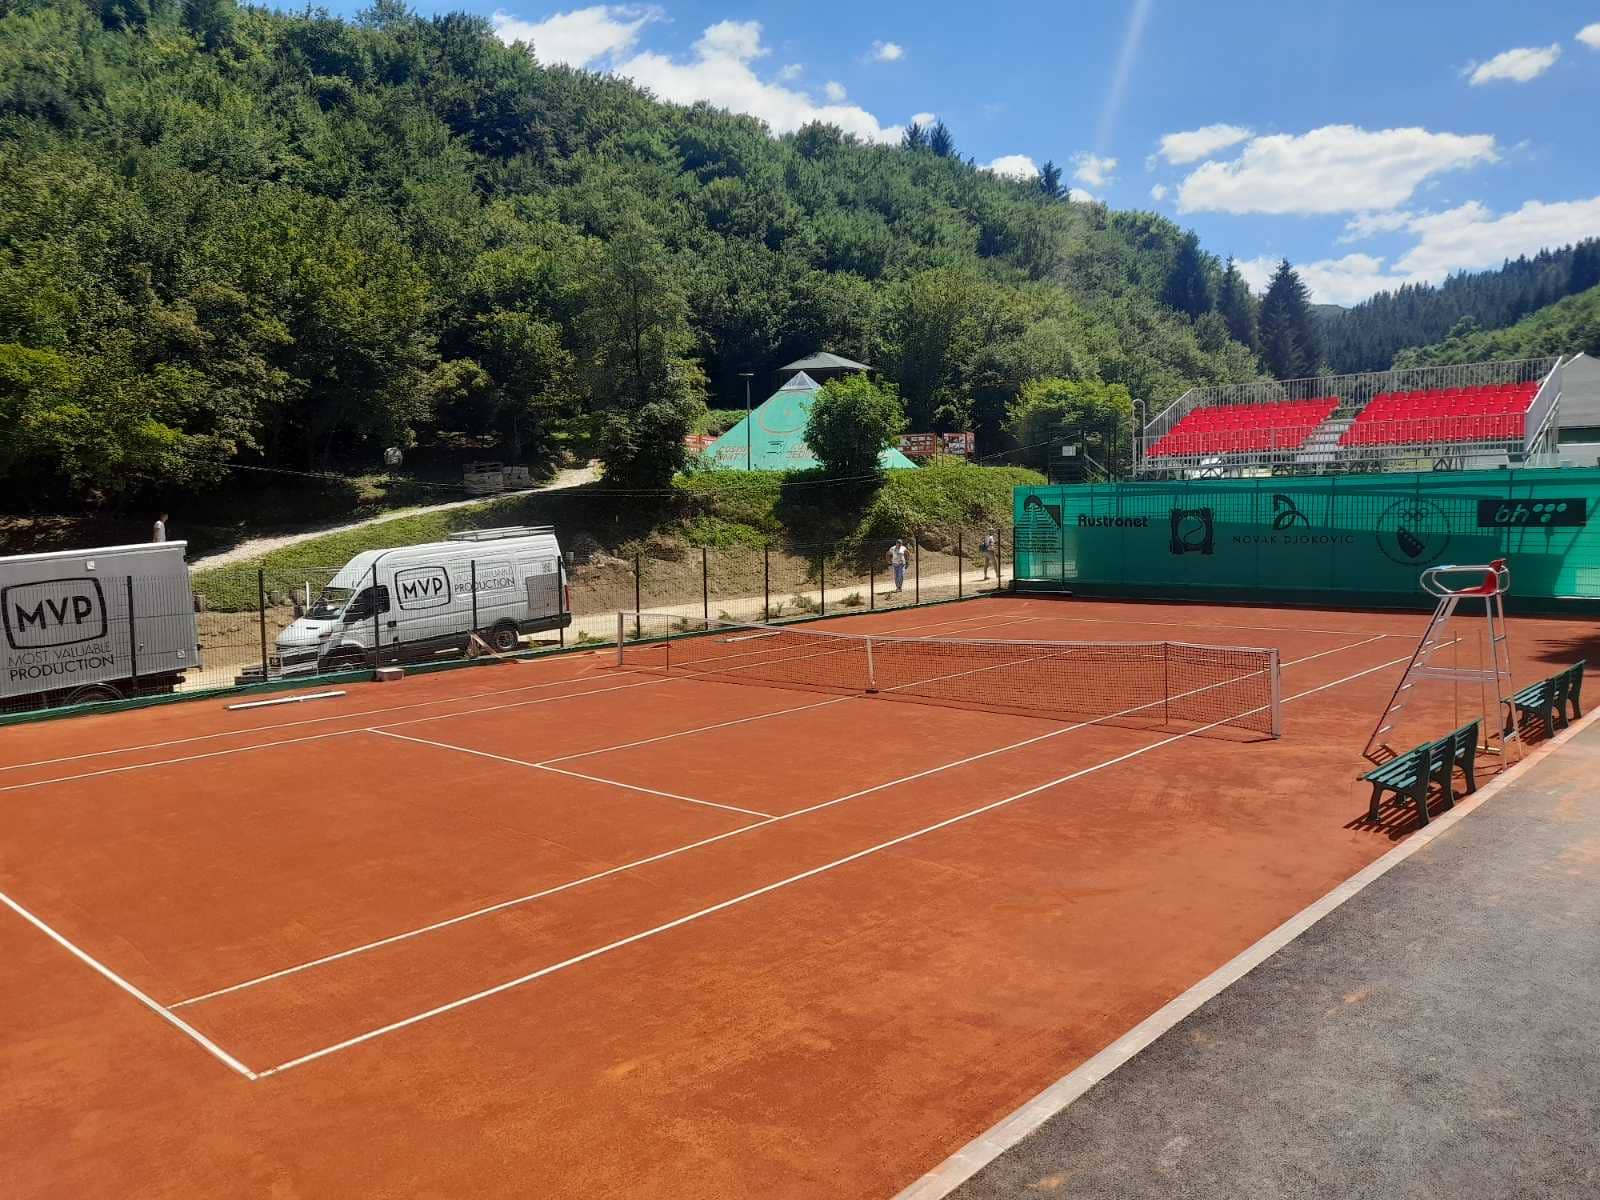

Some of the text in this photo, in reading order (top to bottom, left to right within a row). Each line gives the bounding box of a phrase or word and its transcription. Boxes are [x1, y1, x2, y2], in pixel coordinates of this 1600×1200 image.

[1077, 513, 1149, 528] Rustronet
[1231, 535, 1278, 544] NOVAK
[402, 577, 443, 600] MVP
[454, 578, 515, 593] PRODUCTION
[15, 595, 92, 632] MVP
[9, 642, 112, 665] MOST VALUABLE
[10, 655, 114, 681] PRODUCTION
